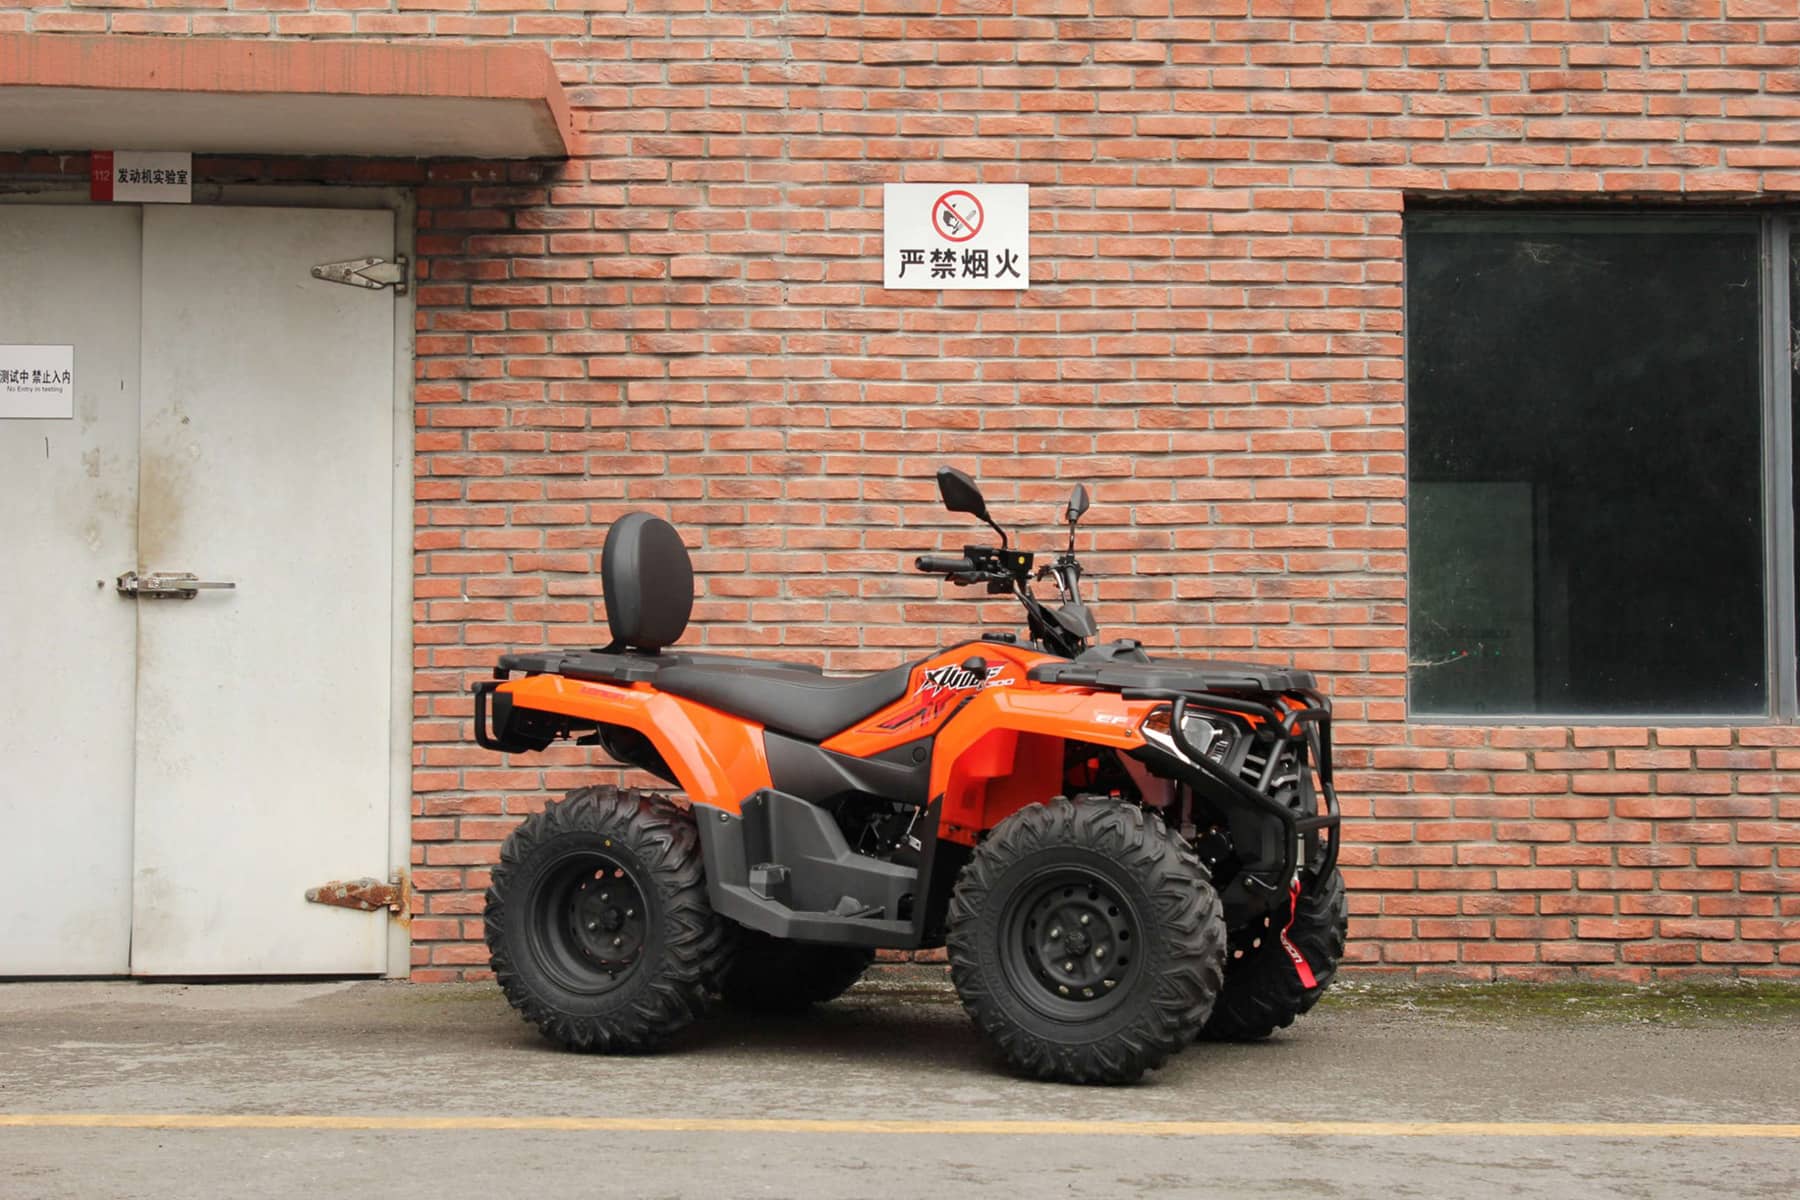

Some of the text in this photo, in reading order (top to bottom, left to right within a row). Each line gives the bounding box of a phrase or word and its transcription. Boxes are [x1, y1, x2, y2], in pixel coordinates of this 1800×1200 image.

[95, 170, 110, 181] 112
[118, 168, 188, 184] 发动机实验室
[898, 248, 1020, 279] 严禁烟火
[32, 369, 70, 384] 禁止入内
